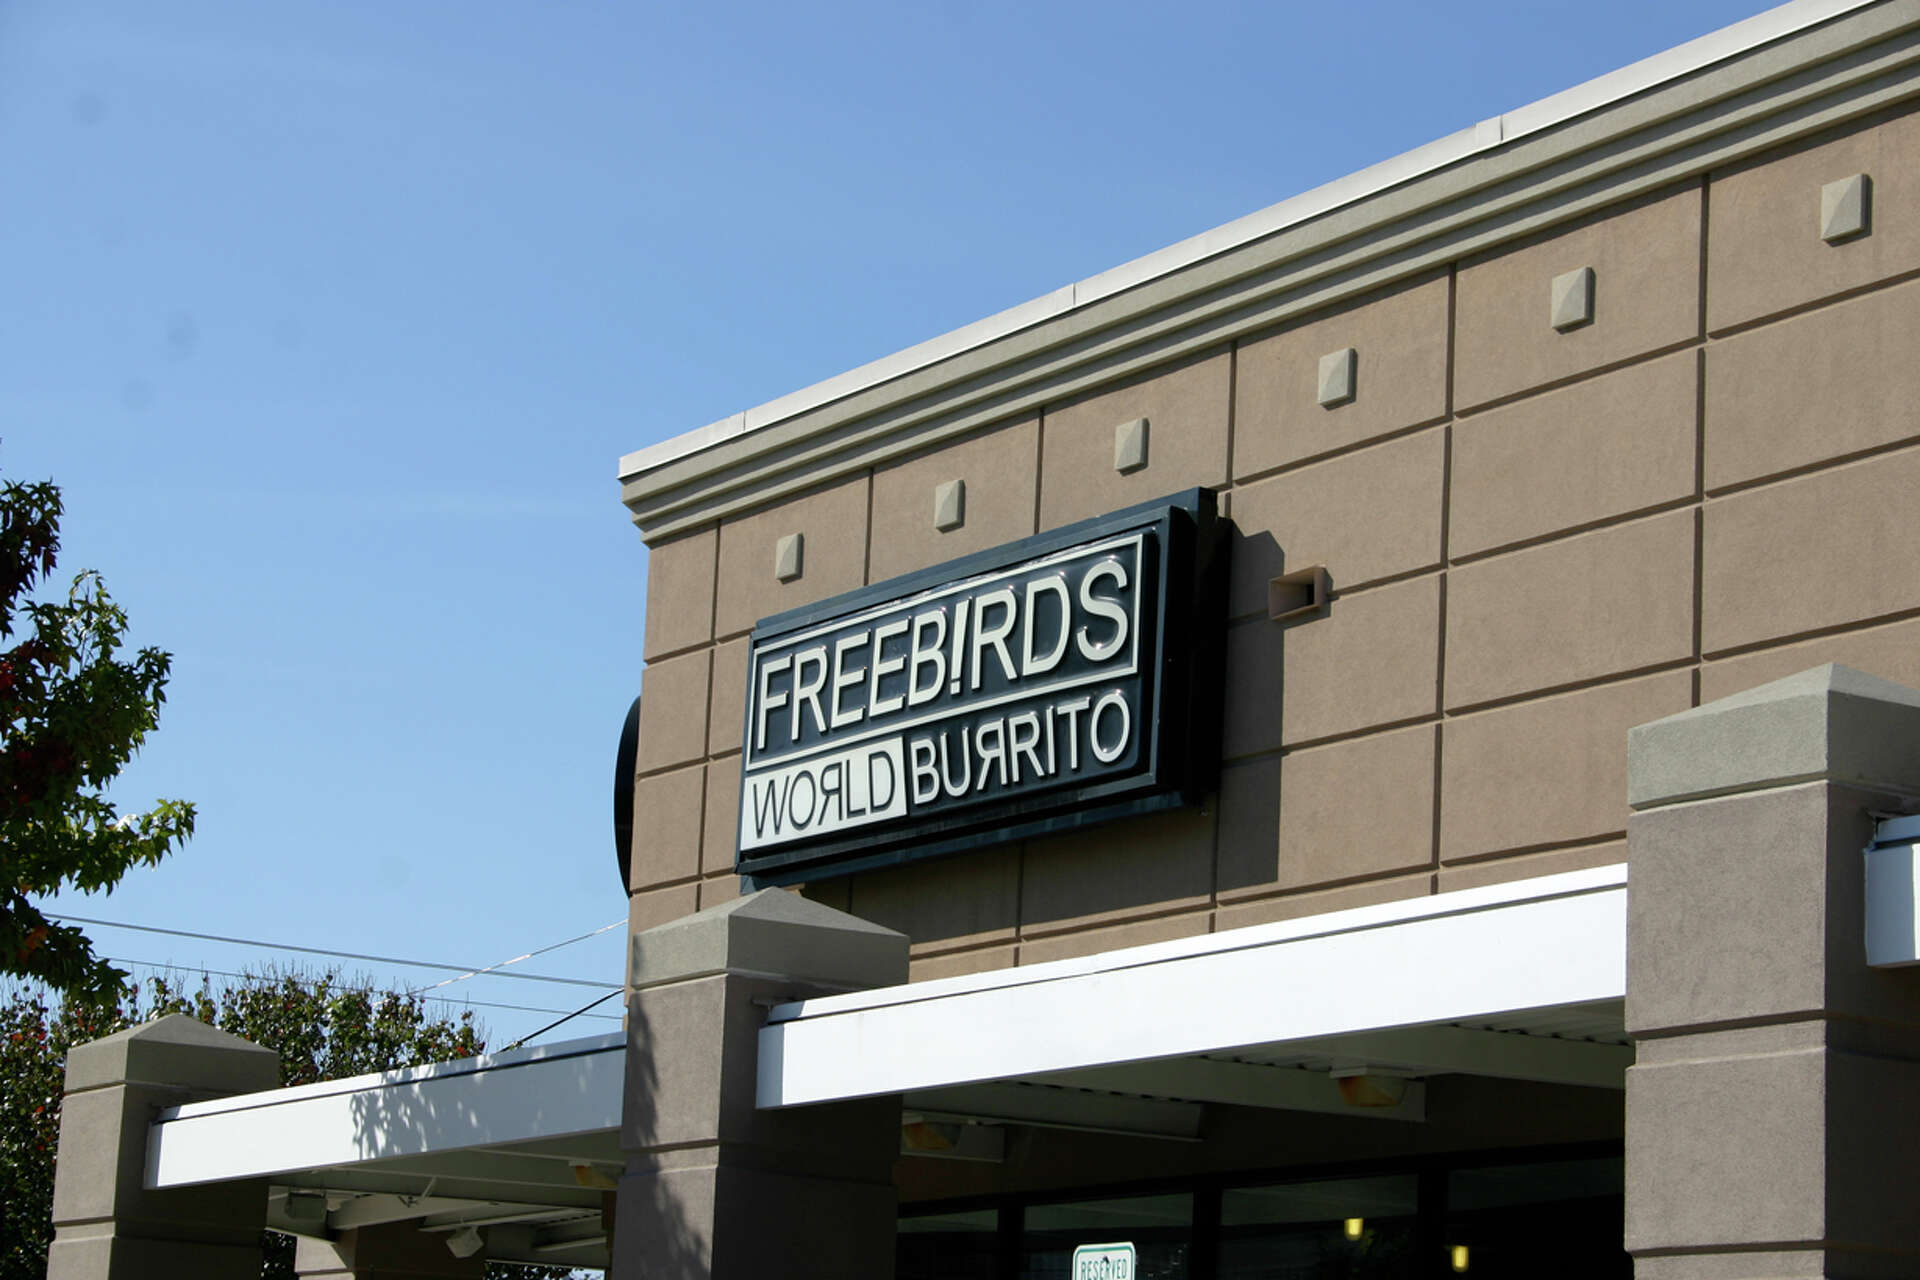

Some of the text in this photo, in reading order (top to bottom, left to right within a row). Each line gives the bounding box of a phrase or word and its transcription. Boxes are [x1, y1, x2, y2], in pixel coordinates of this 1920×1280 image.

[752, 690, 1131, 840] WORLD BURRITO
[1080, 1258, 1128, 1280] RESERVED
